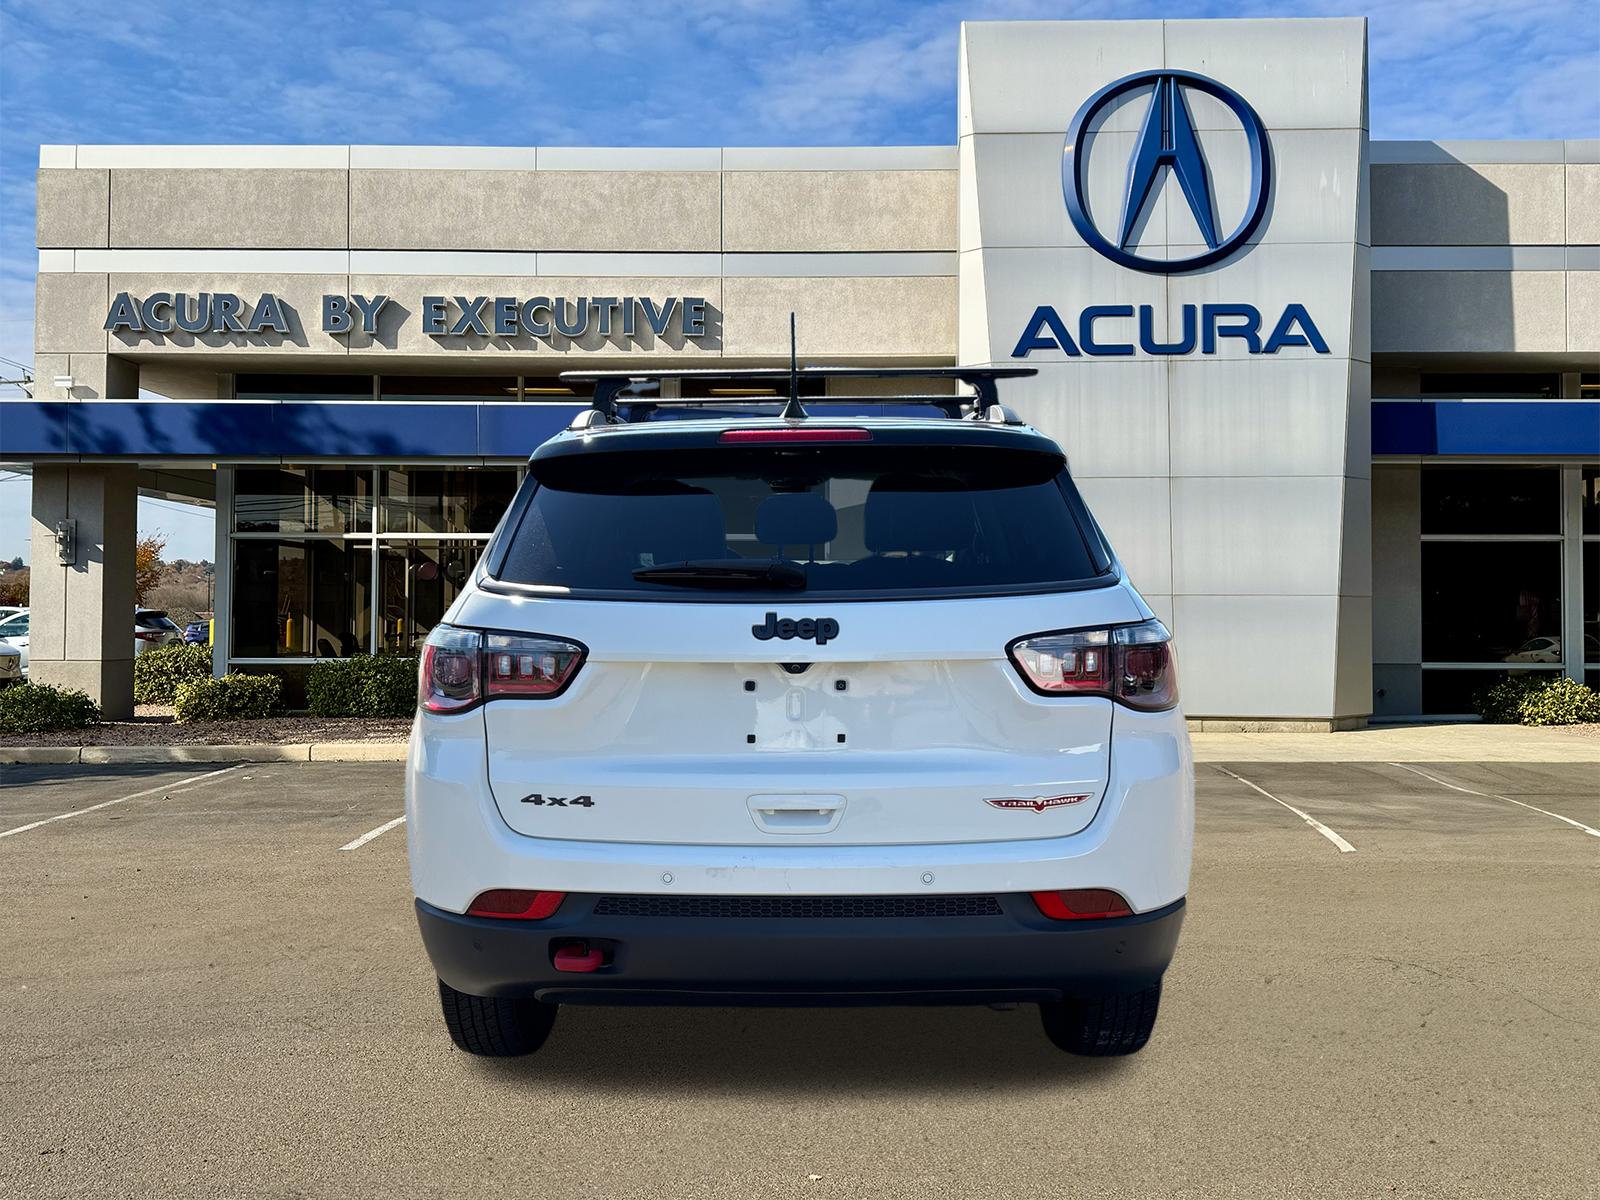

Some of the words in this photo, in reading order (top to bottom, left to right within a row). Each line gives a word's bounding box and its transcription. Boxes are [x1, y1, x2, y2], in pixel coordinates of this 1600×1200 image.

[103, 291, 290, 333] ACURA
[322, 294, 391, 335] BY
[422, 296, 706, 337] EXECUTIVE
[1011, 303, 1332, 357] ACURA
[752, 612, 840, 645] Jeep
[520, 793, 595, 808] 4x4
